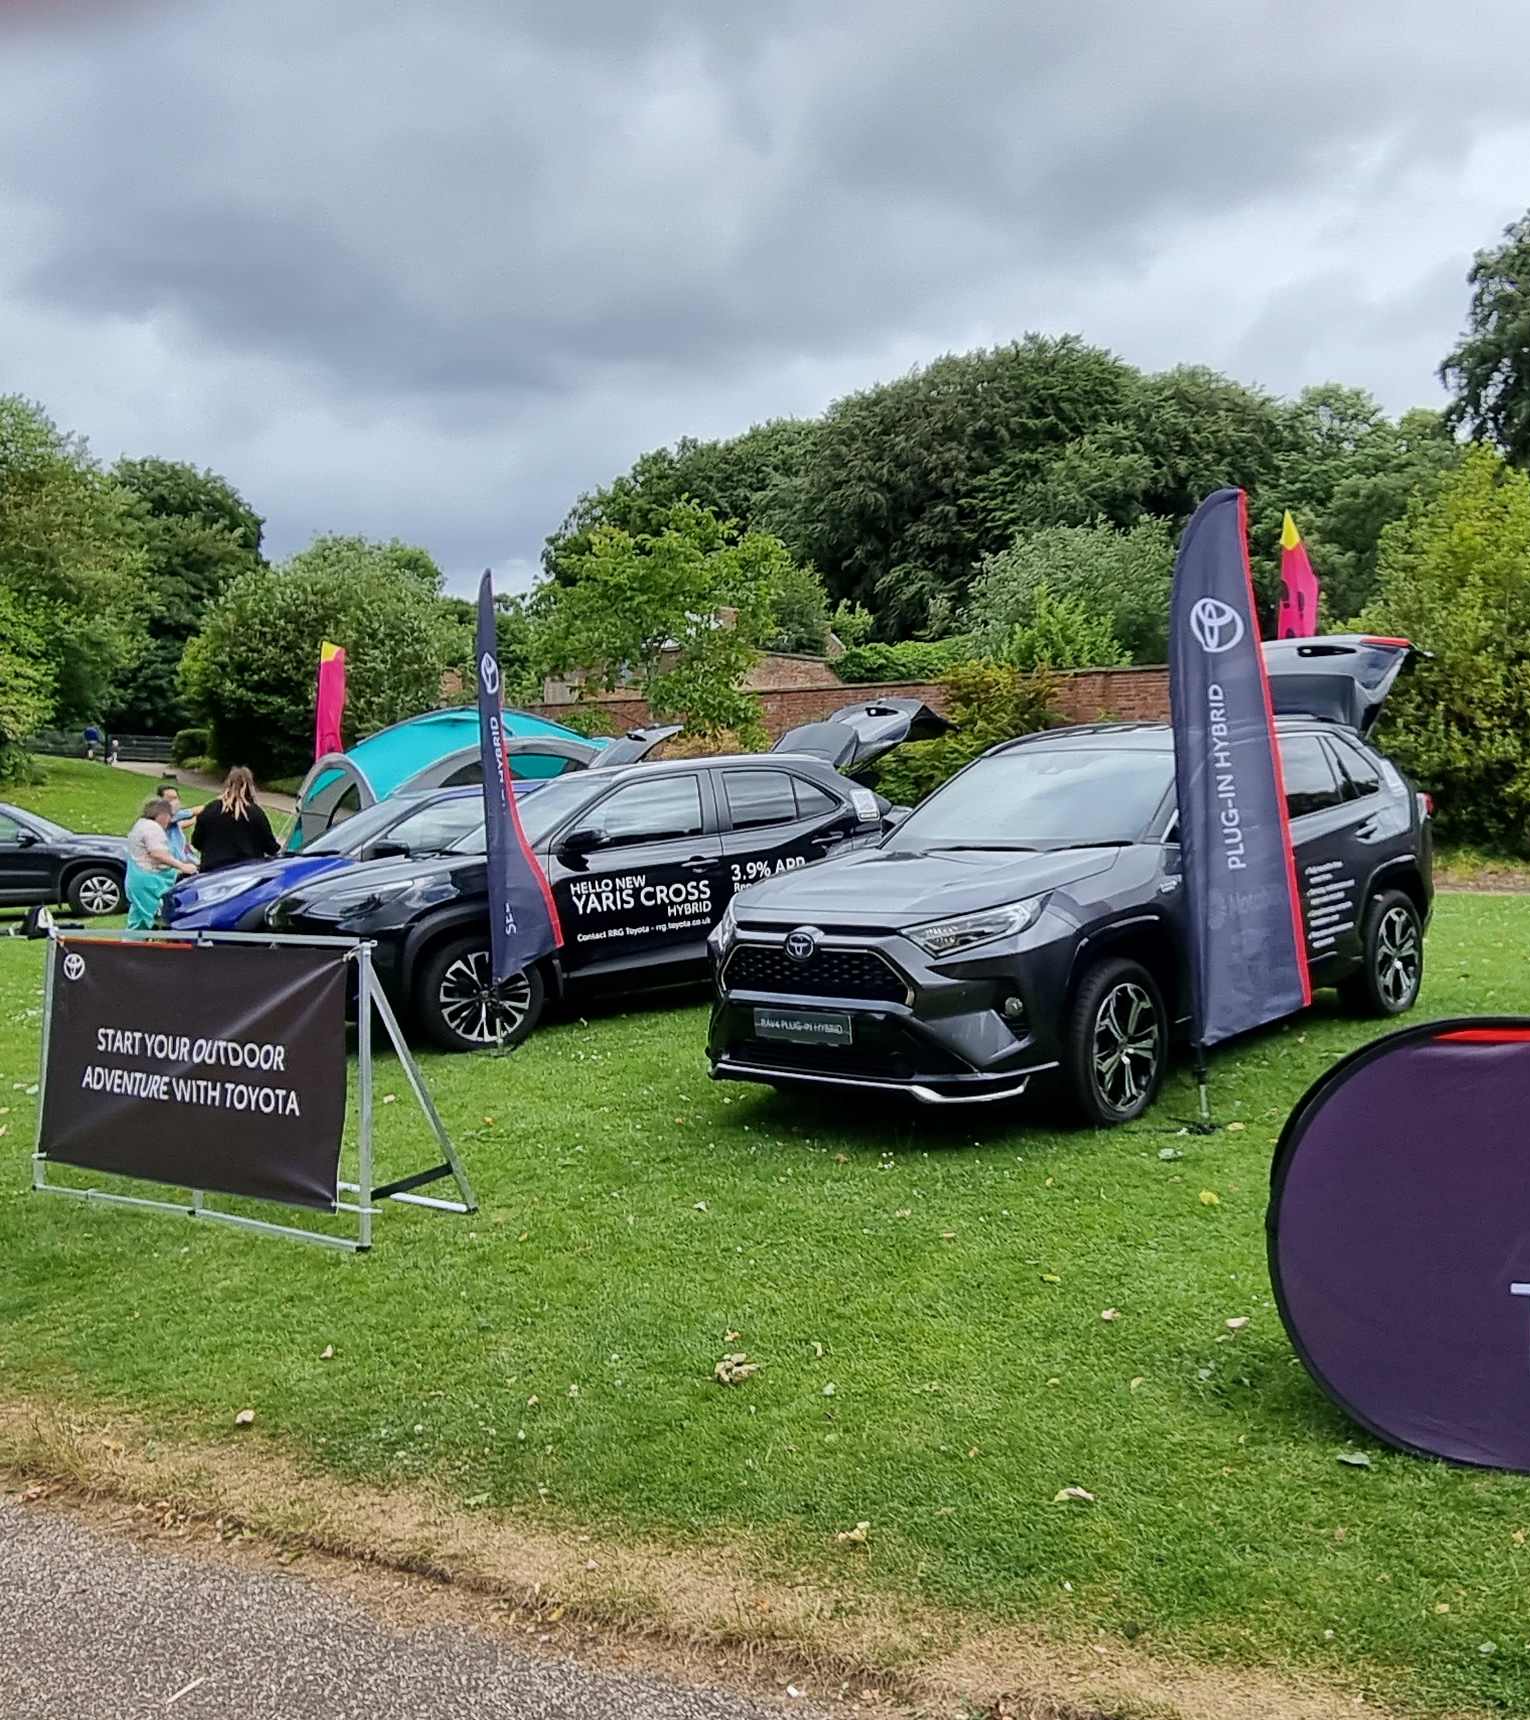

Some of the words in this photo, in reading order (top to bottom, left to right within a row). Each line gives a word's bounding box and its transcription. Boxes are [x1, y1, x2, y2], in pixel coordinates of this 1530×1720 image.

[1208, 684, 1233, 768] HYBRID
[1216, 774, 1247, 870] PLUG-IN
[570, 879, 613, 895] HELLO
[615, 874, 646, 890] NEW
[731, 860, 771, 881] 3.9%
[572, 889, 635, 915] YARIS
[640, 880, 711, 906] CROSS
[667, 901, 712, 917] HYBRID
[577, 930, 607, 942] Contact
[608, 928, 624, 938] RRG
[626, 926, 649, 936] Toyota
[97, 1028, 143, 1056] START
[144, 1033, 189, 1062] YOUR
[192, 1038, 285, 1072] OUTDOOR
[81, 1066, 170, 1100] ADVENTURE
[172, 1077, 221, 1107] WITH
[225, 1083, 301, 1117] TOYOTA
